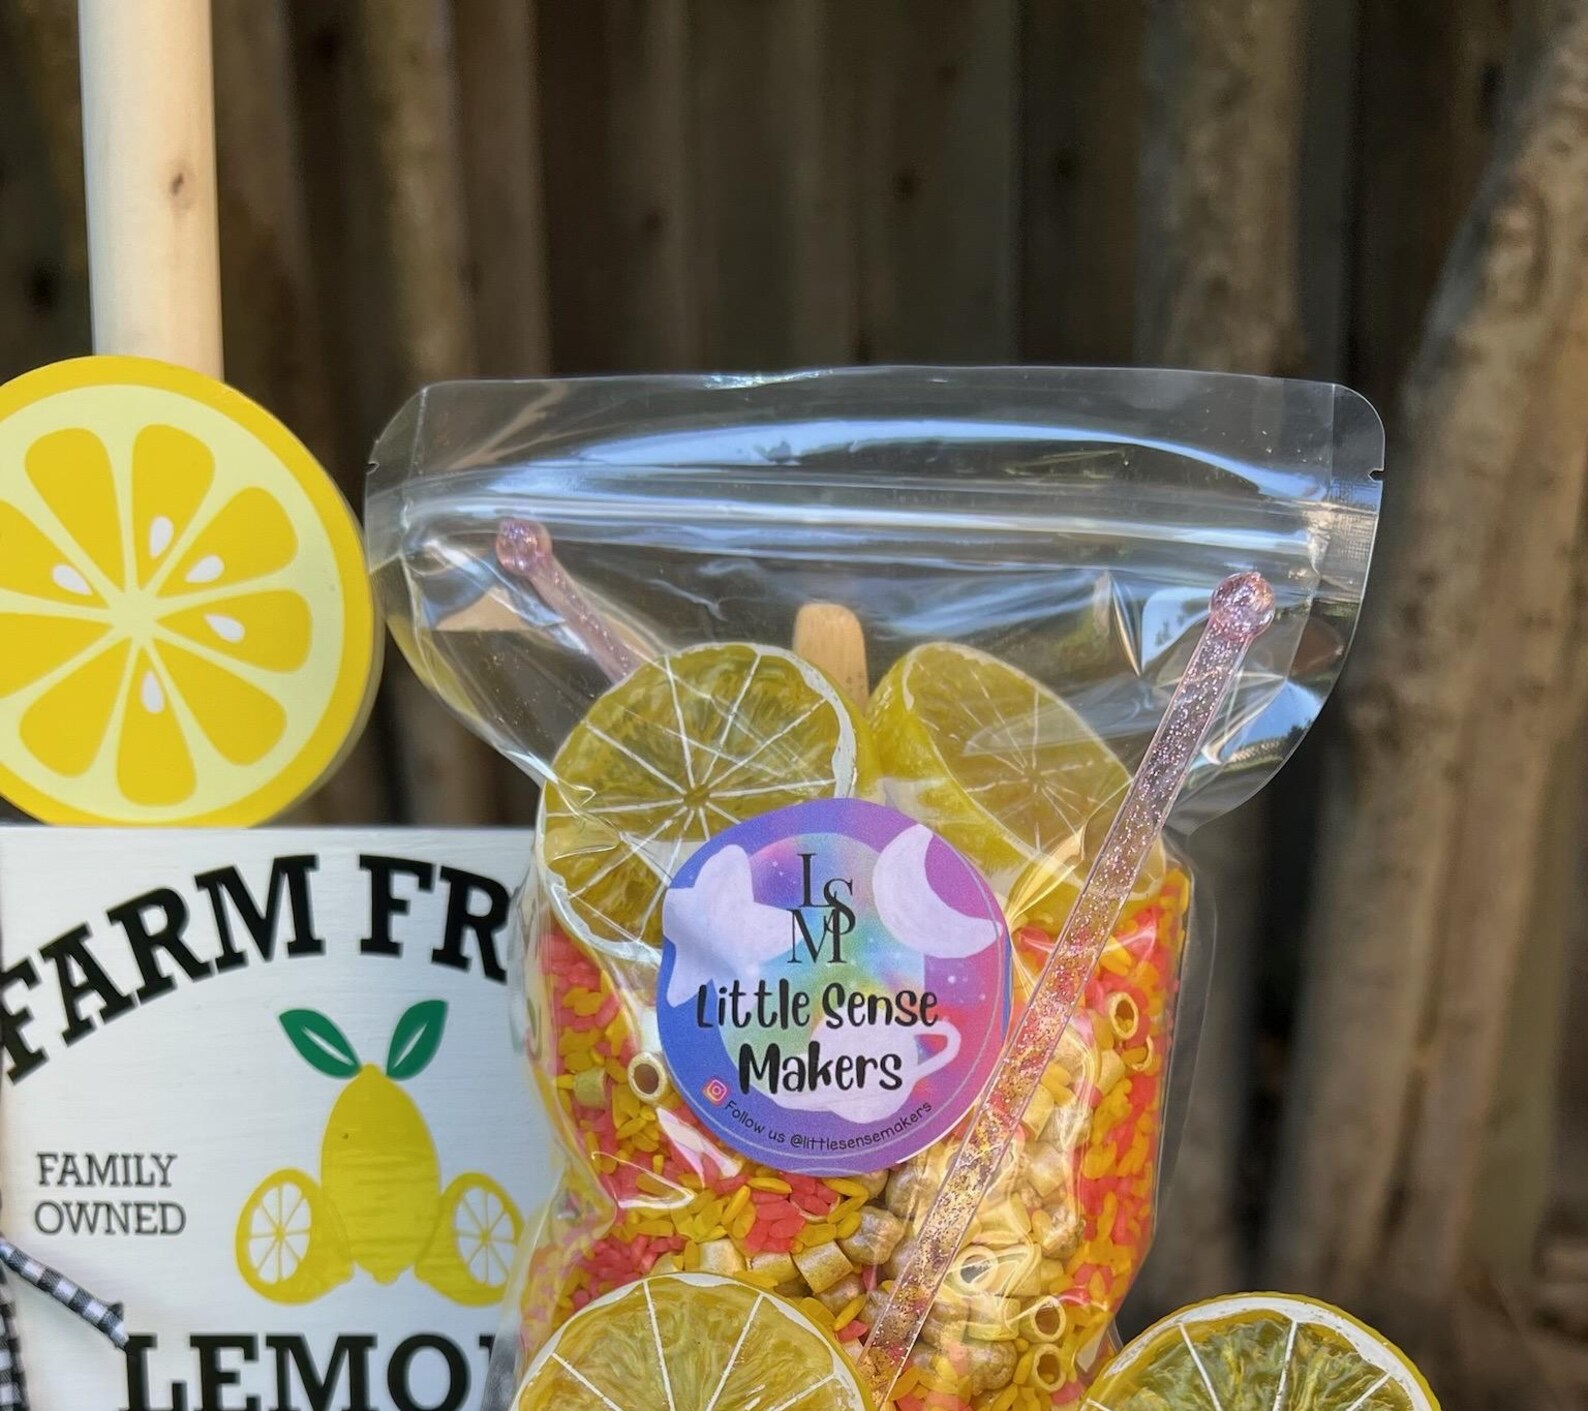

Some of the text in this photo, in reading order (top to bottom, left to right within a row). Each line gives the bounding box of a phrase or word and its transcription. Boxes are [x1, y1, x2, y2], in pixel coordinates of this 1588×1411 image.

[0, 854, 510, 1086] FARM FR
[696, 978, 939, 1030] Little Sense
[738, 1041, 904, 1095] Makers
[724, 1100, 933, 1151] Follow us @littlesensemakers
[36, 1152, 178, 1188] FAMILY
[34, 1201, 187, 1236] OWNED
